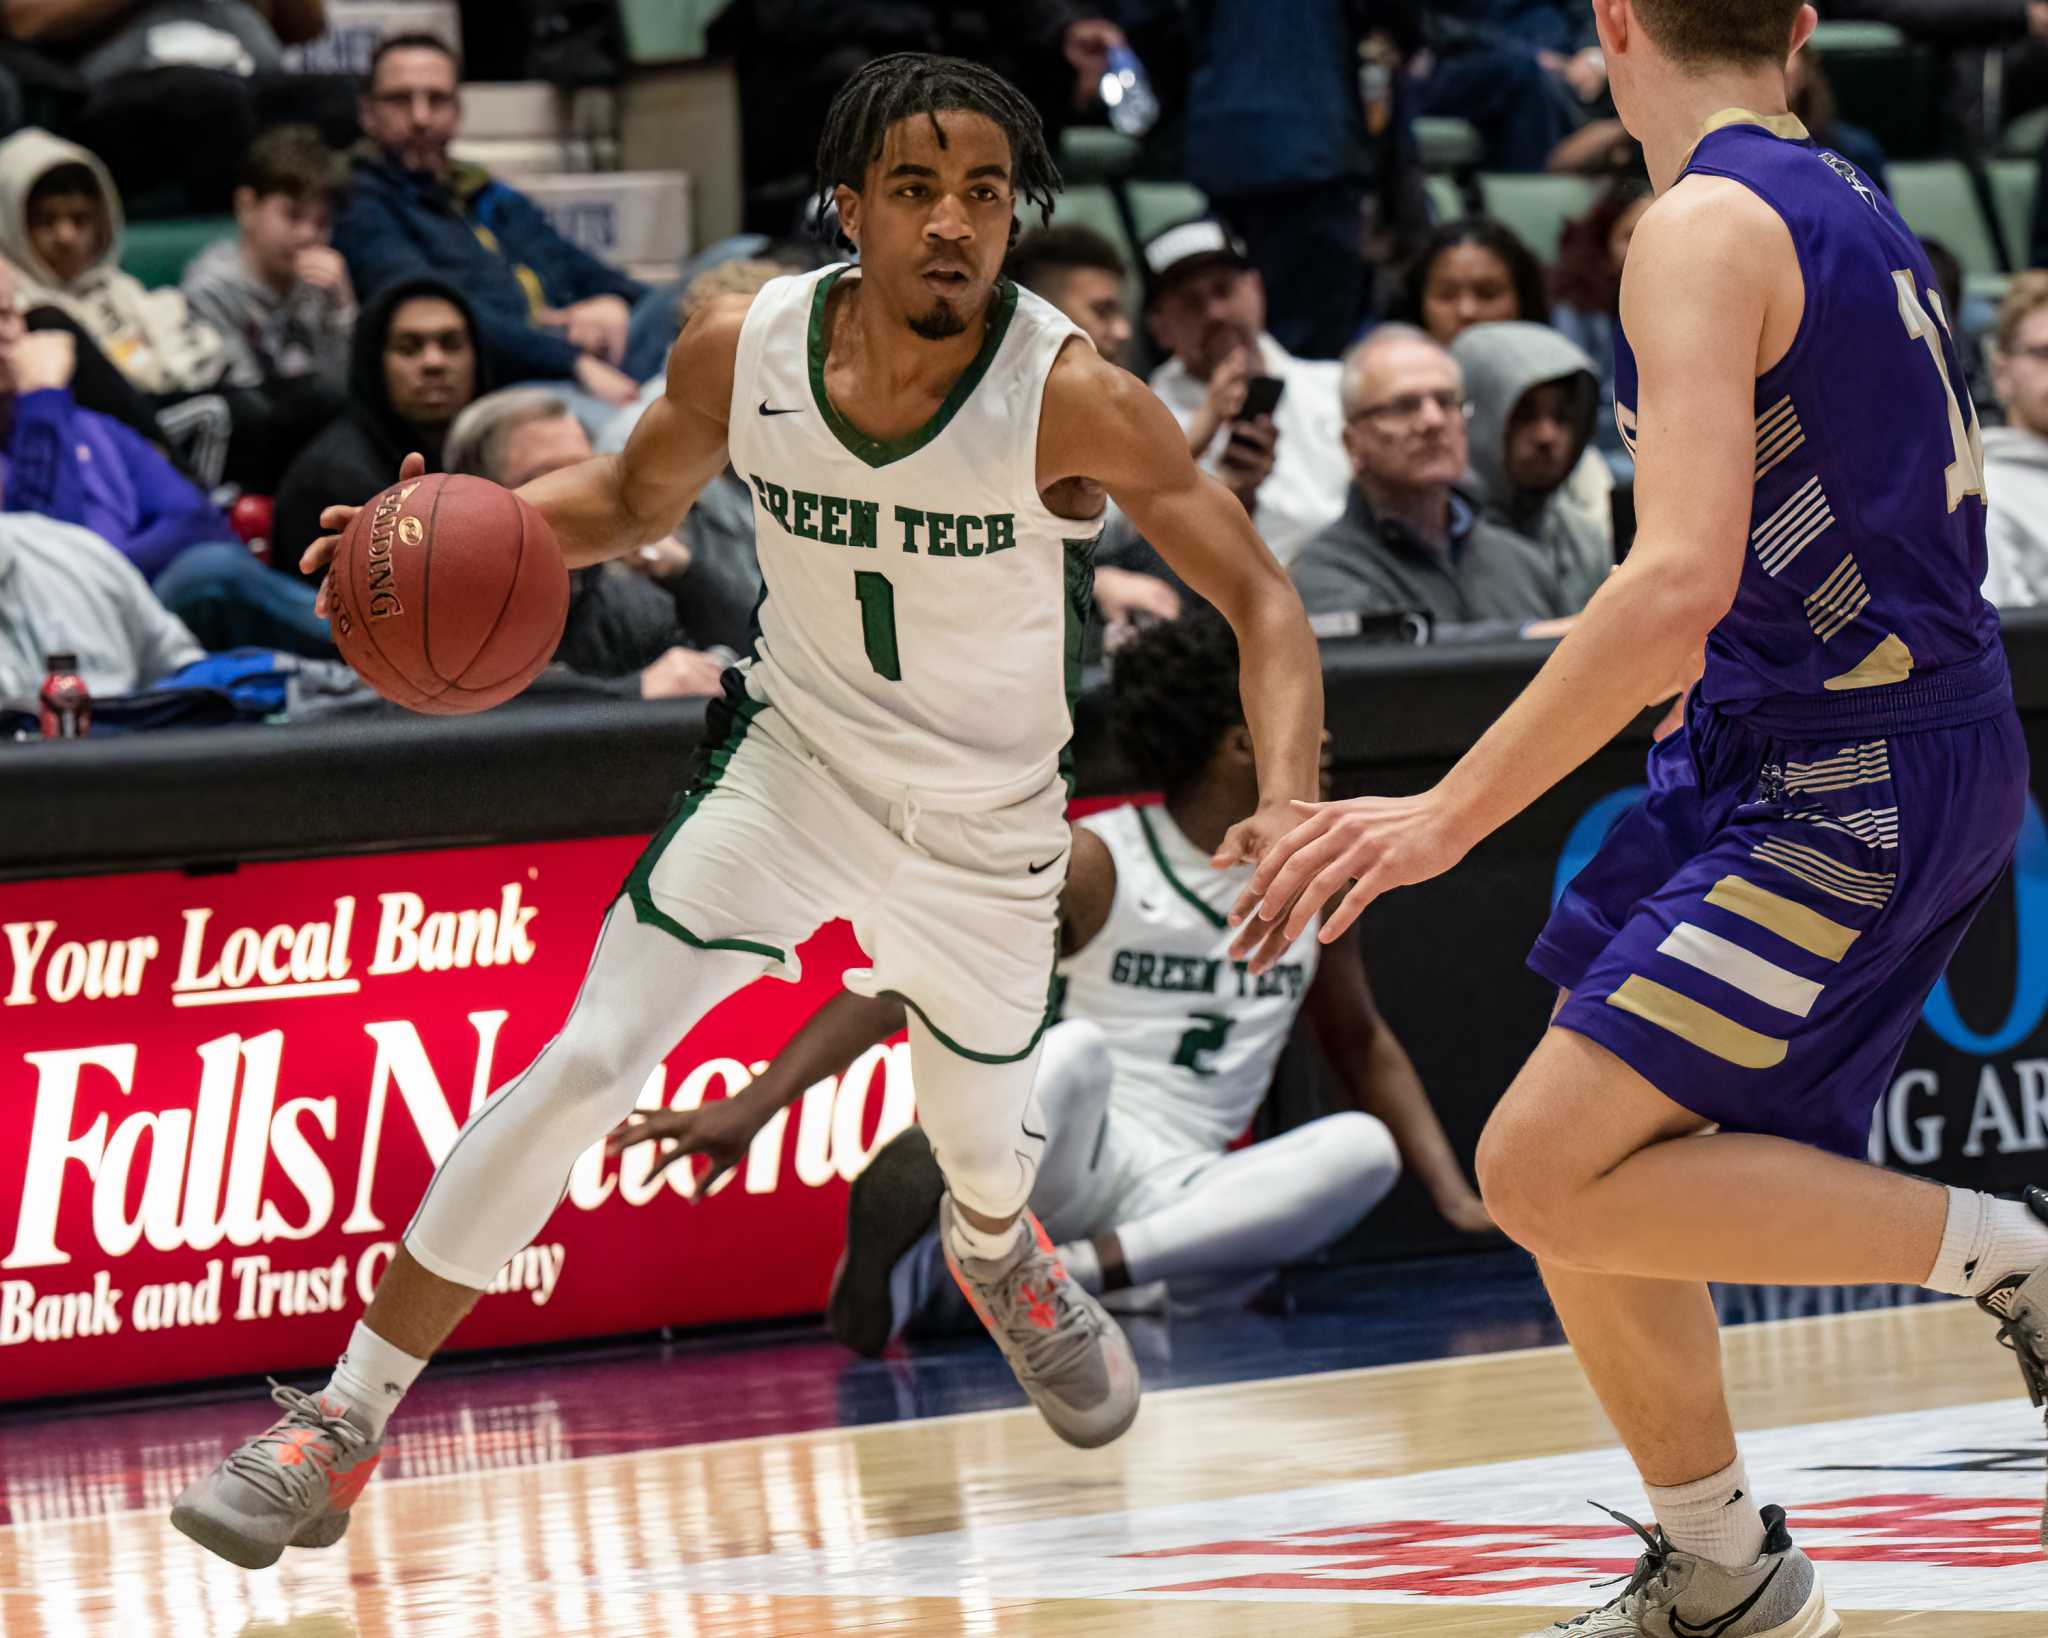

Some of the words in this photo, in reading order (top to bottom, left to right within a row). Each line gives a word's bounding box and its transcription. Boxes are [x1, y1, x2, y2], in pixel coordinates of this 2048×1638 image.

[368, 490, 404, 617] ALDING
[854, 570, 902, 681] 1
[2, 919, 159, 1006] Your
[172, 896, 356, 994] Local
[368, 882, 539, 976] Bank
[1172, 1012, 1237, 1076] 2
[0, 1029, 338, 1269] Falls
[0, 1271, 123, 1346] Bank
[132, 1259, 223, 1332] and
[232, 1255, 349, 1321] Trust
